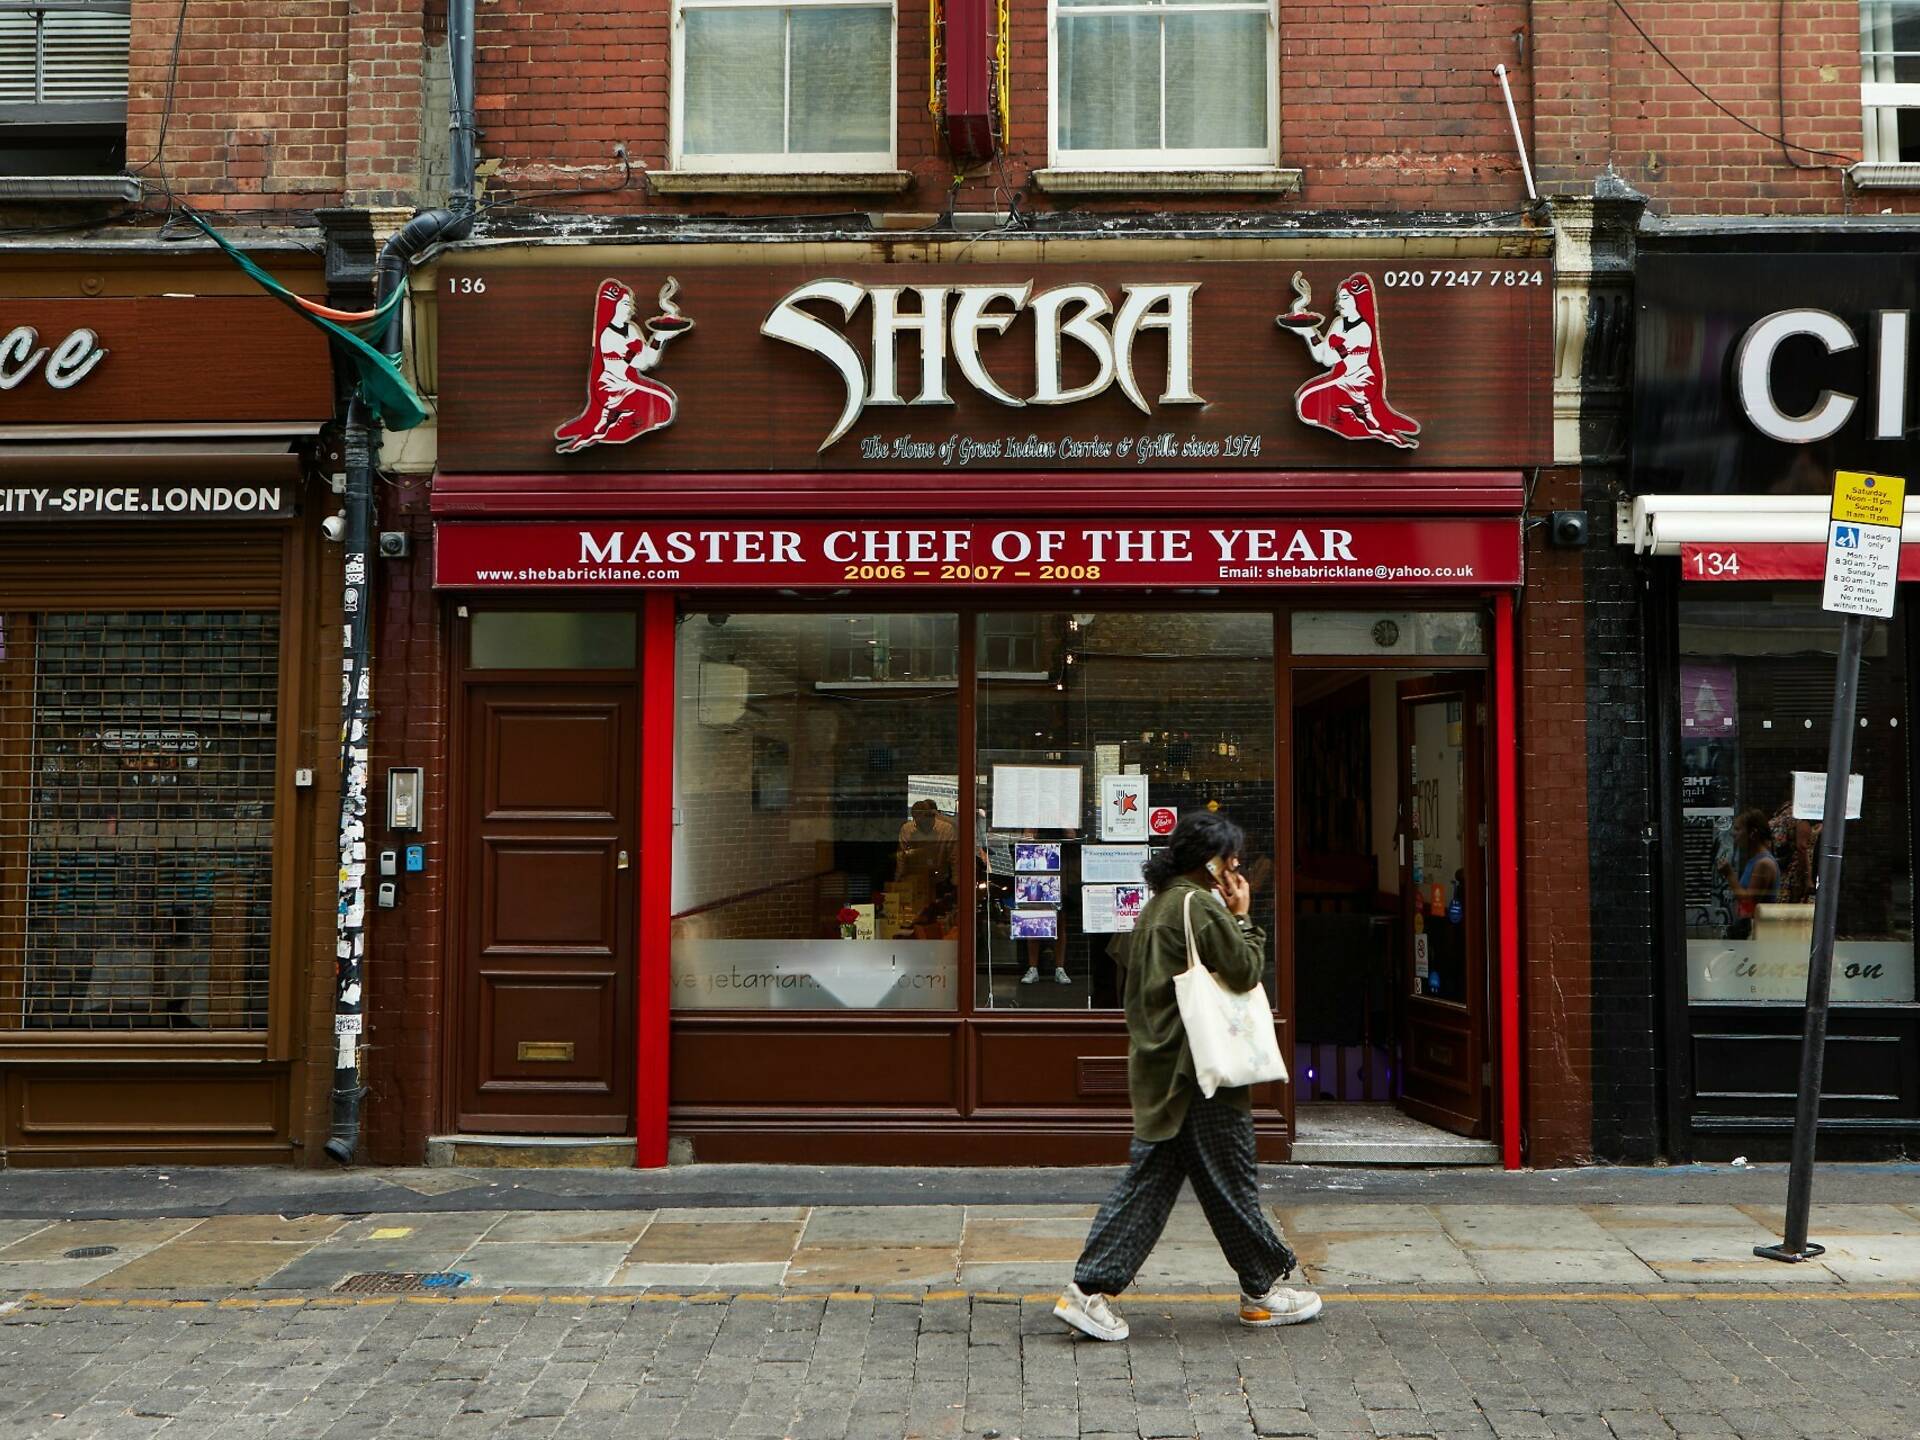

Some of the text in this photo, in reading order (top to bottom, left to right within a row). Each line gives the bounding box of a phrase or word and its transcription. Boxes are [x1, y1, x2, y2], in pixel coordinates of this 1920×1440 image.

[449, 277, 486, 294] 136
[1384, 270, 1543, 287] 020 7247 7824
[760, 278, 1206, 453] SHEBA
[1732, 308, 1910, 444] CI
[861, 434, 1262, 466] The Home of Great Indian Curries & Grills since 1974
[1846, 494, 1866, 502] Noon
[1852, 486, 1887, 498] Saturday
[1855, 503, 1883, 513] Sunday
[1864, 532, 1891, 542] loading
[578, 529, 1358, 563] MASTER CHEF OF THE YEAR
[1868, 541, 1884, 549] only
[1847, 551, 1863, 559] Mon
[1692, 552, 1740, 576] 134
[476, 567, 680, 581] www.shebabricklane.com
[844, 565, 906, 581] 2006
[940, 565, 1005, 580] 2007
[1039, 565, 1101, 580] 2008
[1219, 564, 1475, 580] Email: shebabricklane@yahoo.co.uk
[1847, 567, 1875, 577] Sunday
[1843, 585, 1875, 595] 20 mins
[1854, 596, 1878, 604] return
[1833, 602, 1857, 610] within
[1866, 605, 1883, 613] hour
[1703, 948, 1885, 984] Cinnaon
